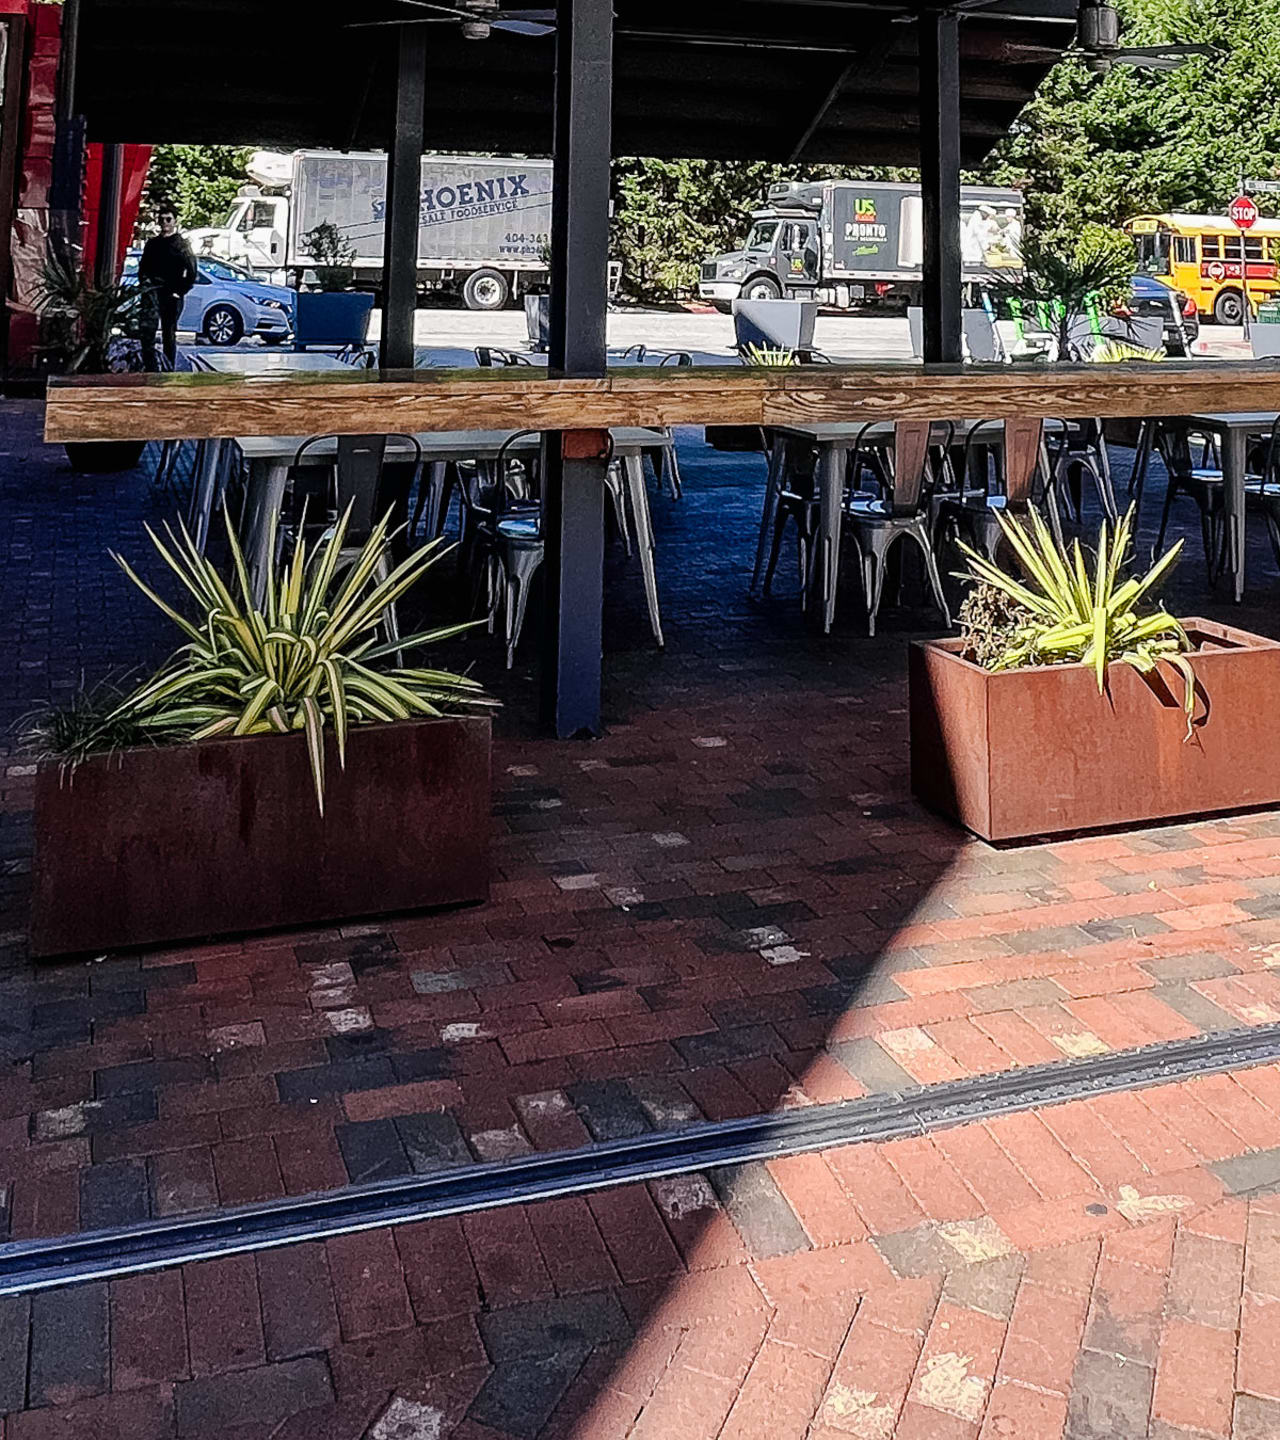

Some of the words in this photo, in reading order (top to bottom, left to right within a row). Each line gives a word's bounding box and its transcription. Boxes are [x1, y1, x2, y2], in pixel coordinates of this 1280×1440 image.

[420, 174, 529, 212] HOENIX
[1233, 206, 1255, 221] STOP
[845, 223, 886, 237] PRONTO
[504, 232, 549, 243] 404-363
